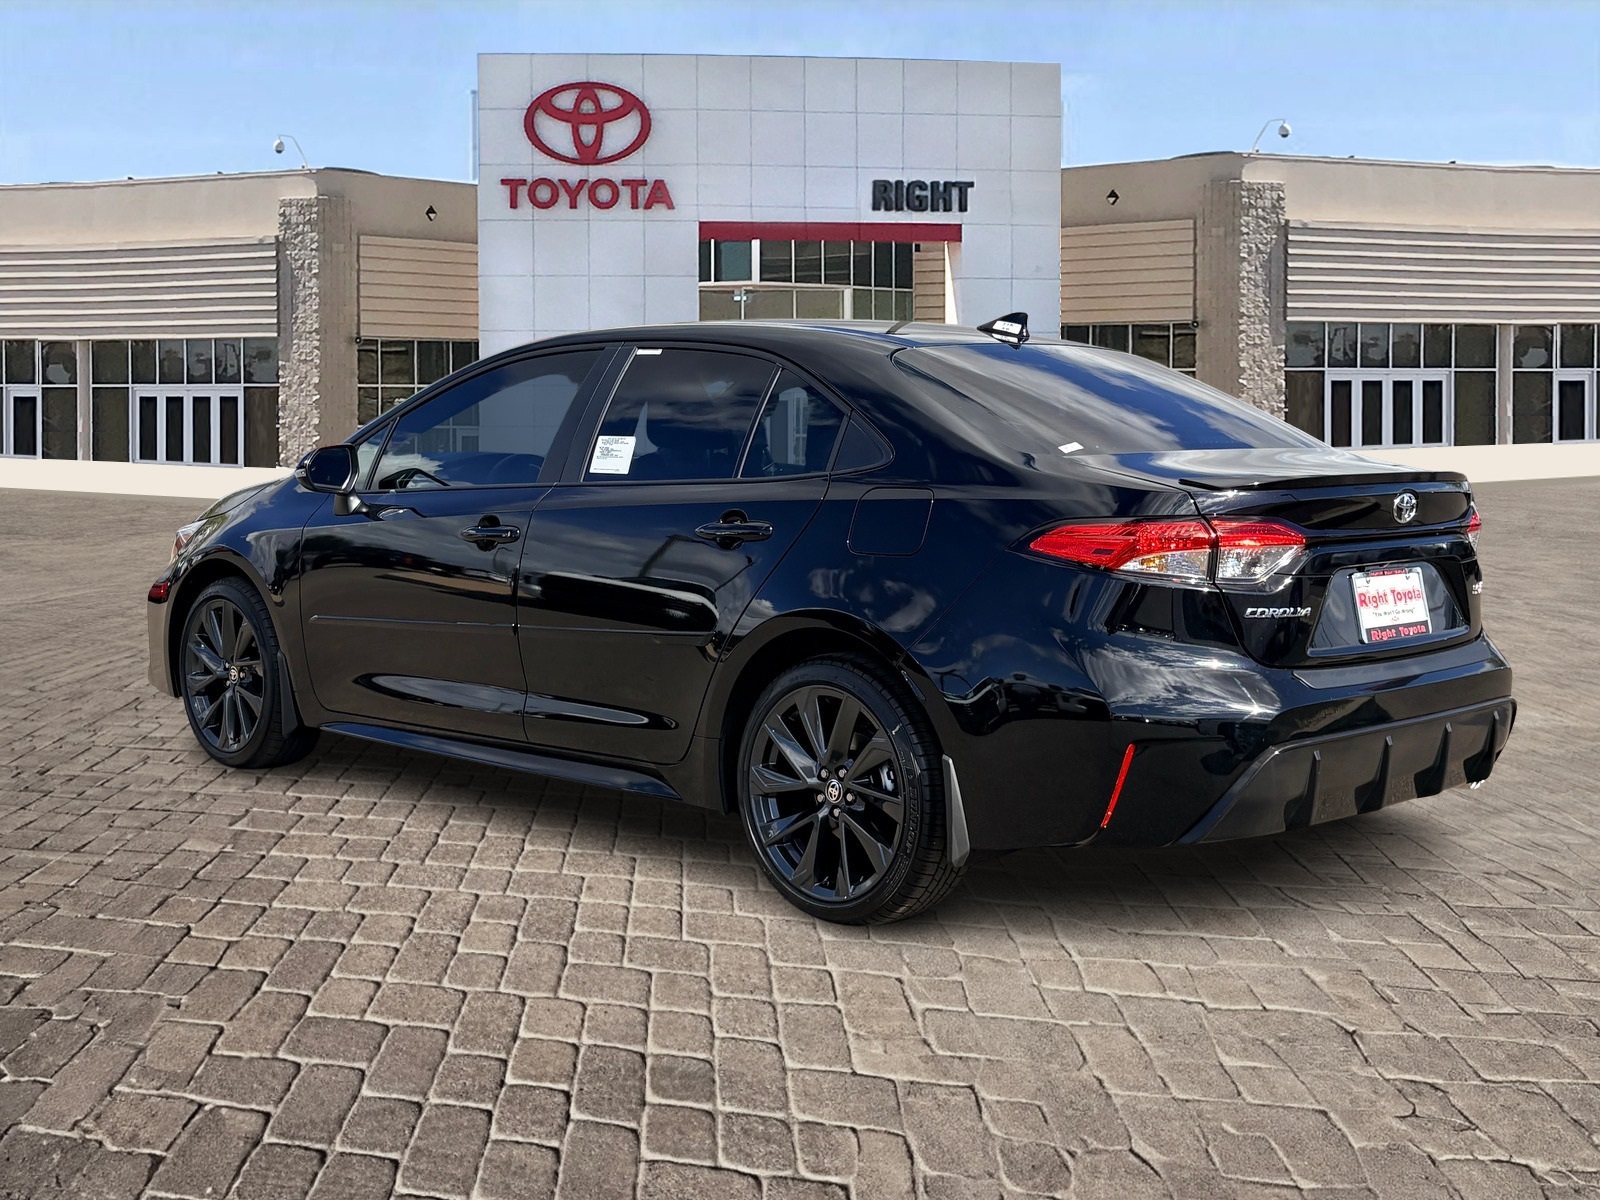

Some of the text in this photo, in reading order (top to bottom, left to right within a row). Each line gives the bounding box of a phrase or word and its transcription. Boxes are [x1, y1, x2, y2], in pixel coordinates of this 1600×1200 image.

[500, 177, 675, 210] TOYOTA
[872, 179, 975, 213] RIGHT
[1358, 588, 1422, 608] Right Toyota
[1244, 606, 1312, 619] COROLLA
[1370, 624, 1426, 641] Right Toyota
